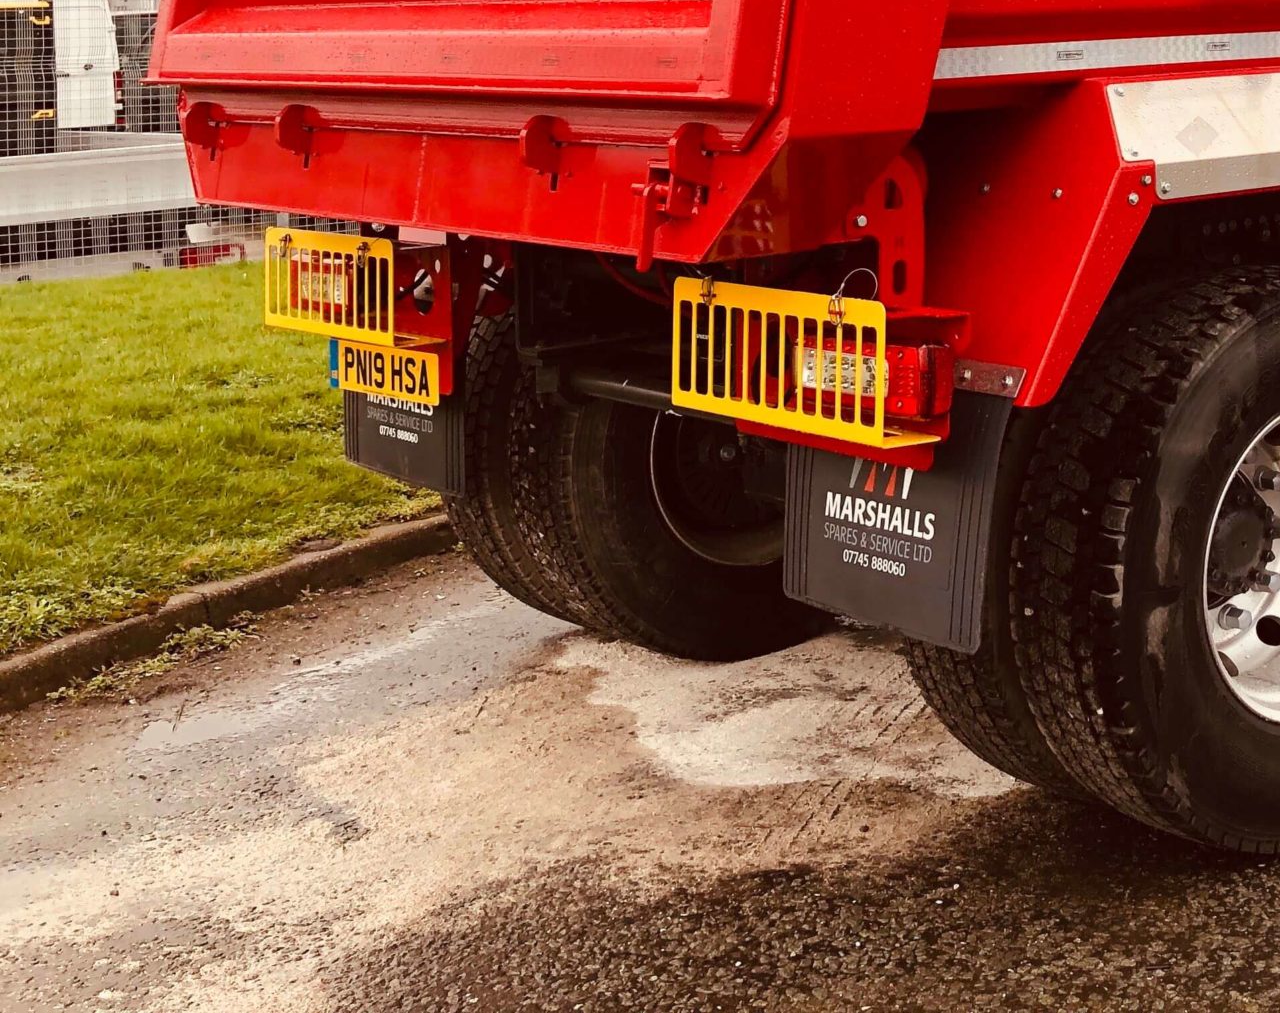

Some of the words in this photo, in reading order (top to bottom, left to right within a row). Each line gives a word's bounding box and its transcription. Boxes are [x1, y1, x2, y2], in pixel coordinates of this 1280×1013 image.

[344, 346, 385, 389] PN19
[391, 354, 430, 398] HSA
[366, 405, 389, 423] SPARES
[389, 411, 395, 424] &
[395, 412, 420, 431] SERVICE
[421, 419, 434, 433] LTD
[379, 424, 396, 438] 07745
[824, 491, 936, 541] MARSHALLS
[823, 521, 858, 546] SPARES
[860, 531, 868, 549] &
[869, 533, 911, 560] SERVICE
[913, 543, 933, 564] LTD
[842, 548, 869, 568] 07745
[871, 555, 906, 577] 888060
